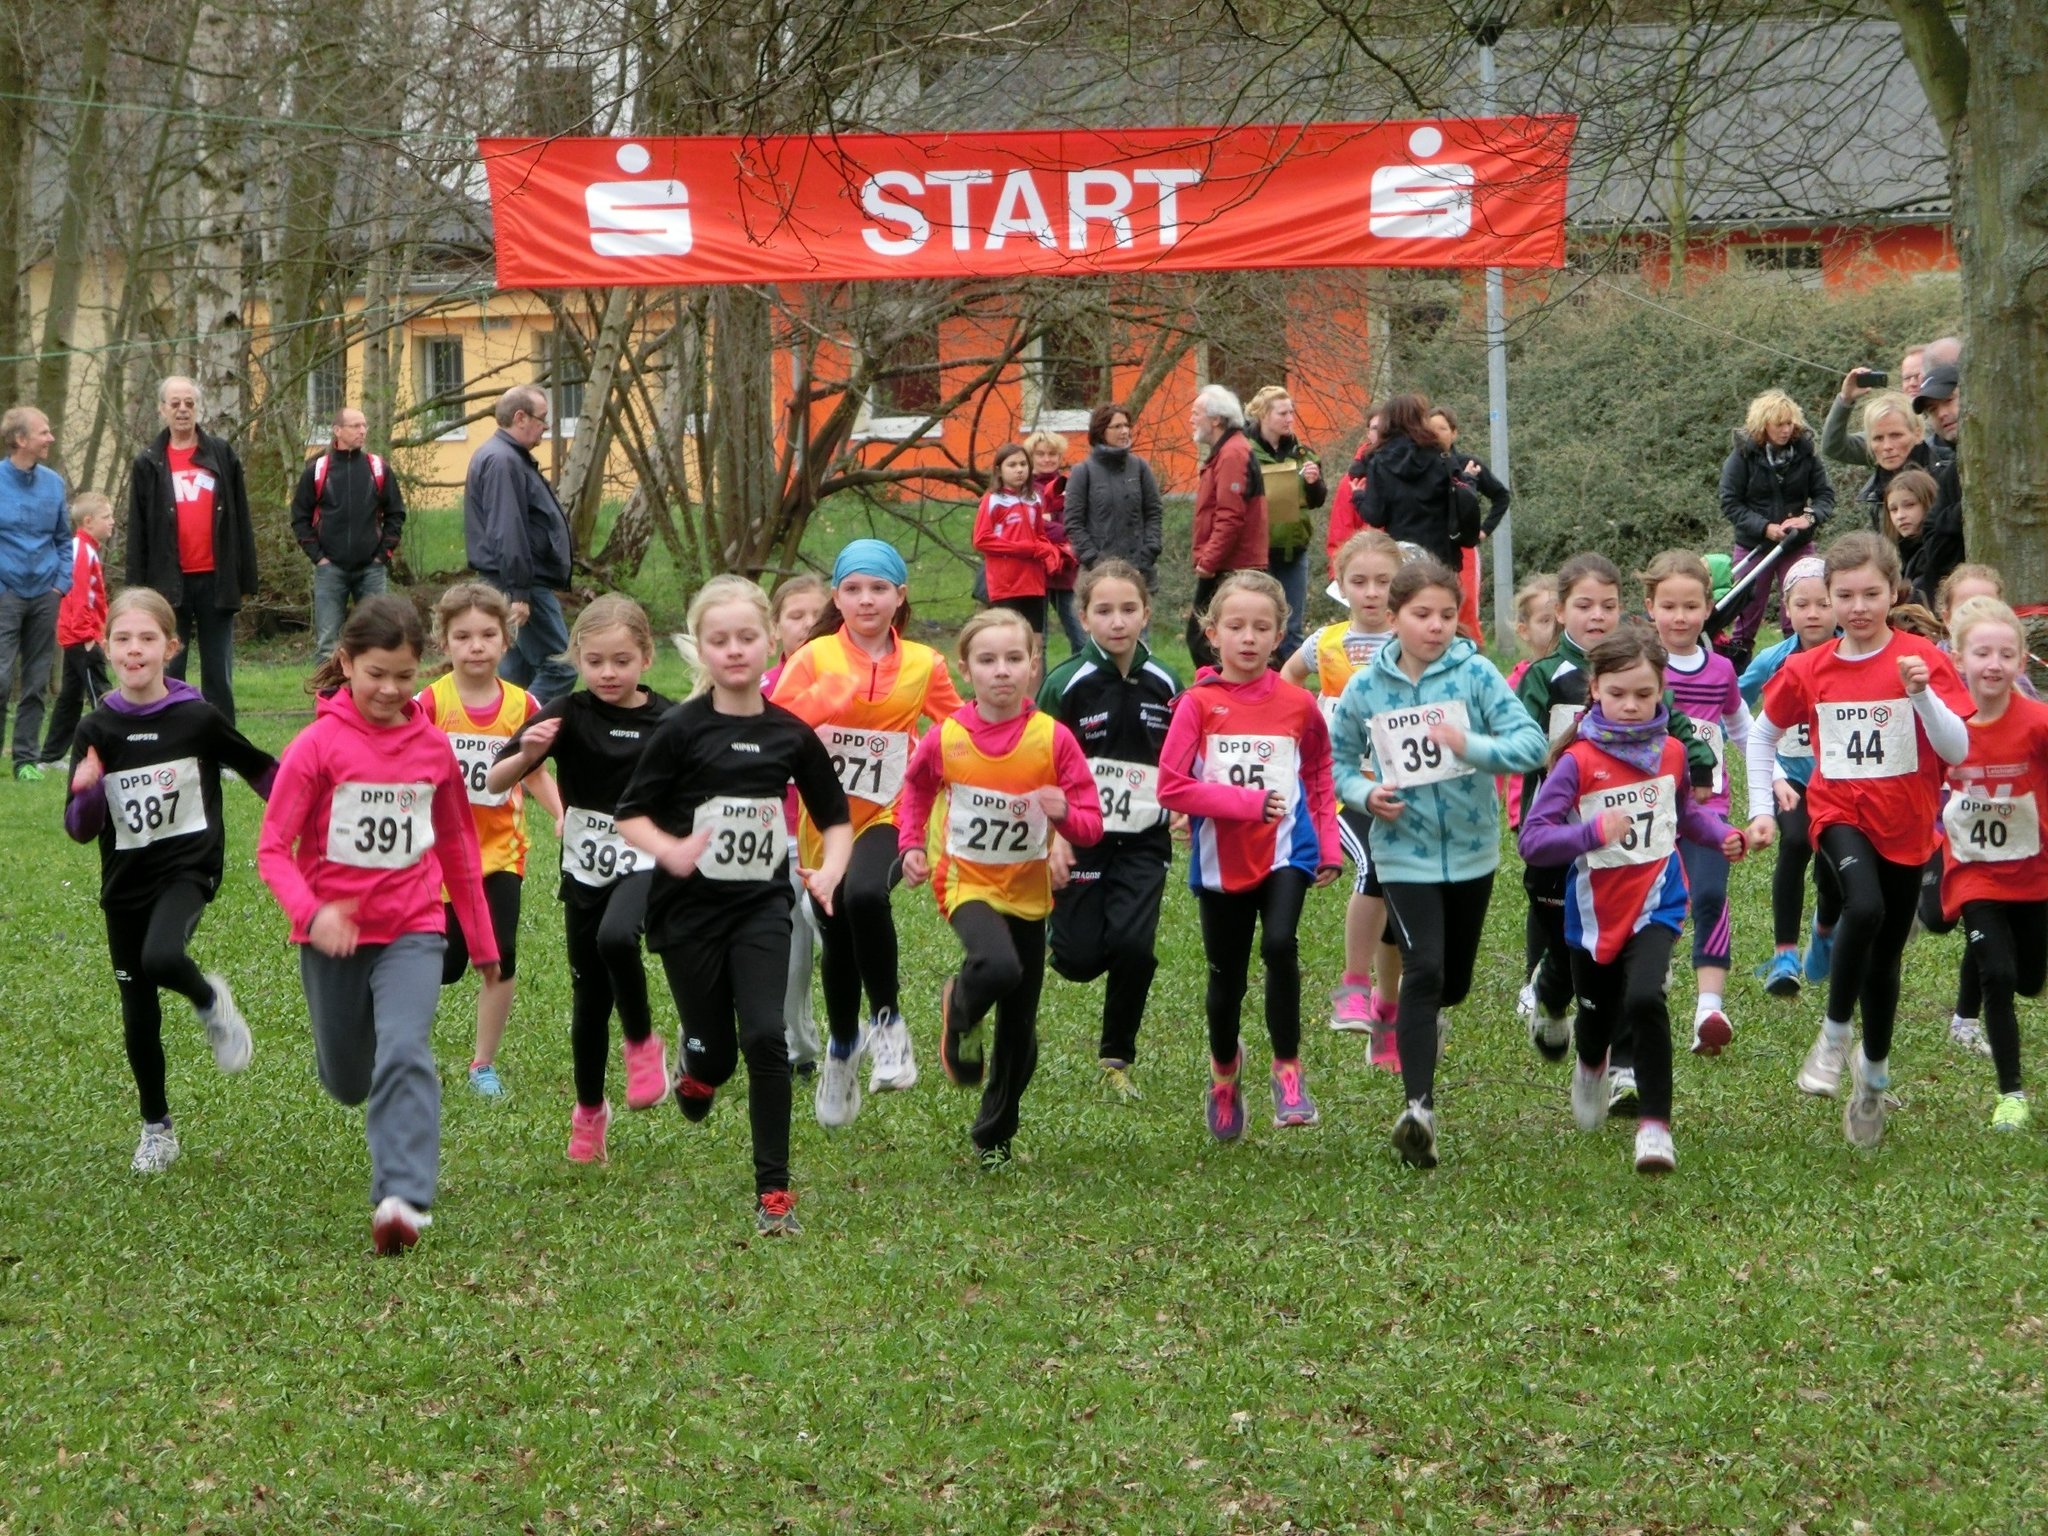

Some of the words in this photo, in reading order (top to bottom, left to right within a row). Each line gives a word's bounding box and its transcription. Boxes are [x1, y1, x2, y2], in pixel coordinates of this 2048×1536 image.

[861, 168, 1202, 257] START
[1388, 713, 1420, 730] DPD
[1836, 708, 1868, 720] DPD
[456, 738, 486, 751] DPD
[832, 732, 865, 747] DPD
[1219, 741, 1251, 753] DPD
[1846, 729, 1884, 765] 44
[1401, 735, 1442, 772] 39
[120, 773, 152, 790] DPD
[830, 755, 883, 793] 271
[1096, 764, 1124, 779] DPD
[1229, 764, 1265, 790] 95
[361, 790, 395, 804] DPD
[972, 794, 1007, 809] DPD
[1100, 787, 1132, 822] 34
[1604, 791, 1638, 808] DPD
[1961, 800, 1992, 813] DPD
[125, 790, 180, 834] 387
[723, 805, 757, 818] DPD
[355, 816, 413, 854] 391
[967, 817, 1029, 851] 272
[1970, 820, 2007, 849] 40
[715, 829, 774, 866] 394
[579, 839, 637, 878] 393
